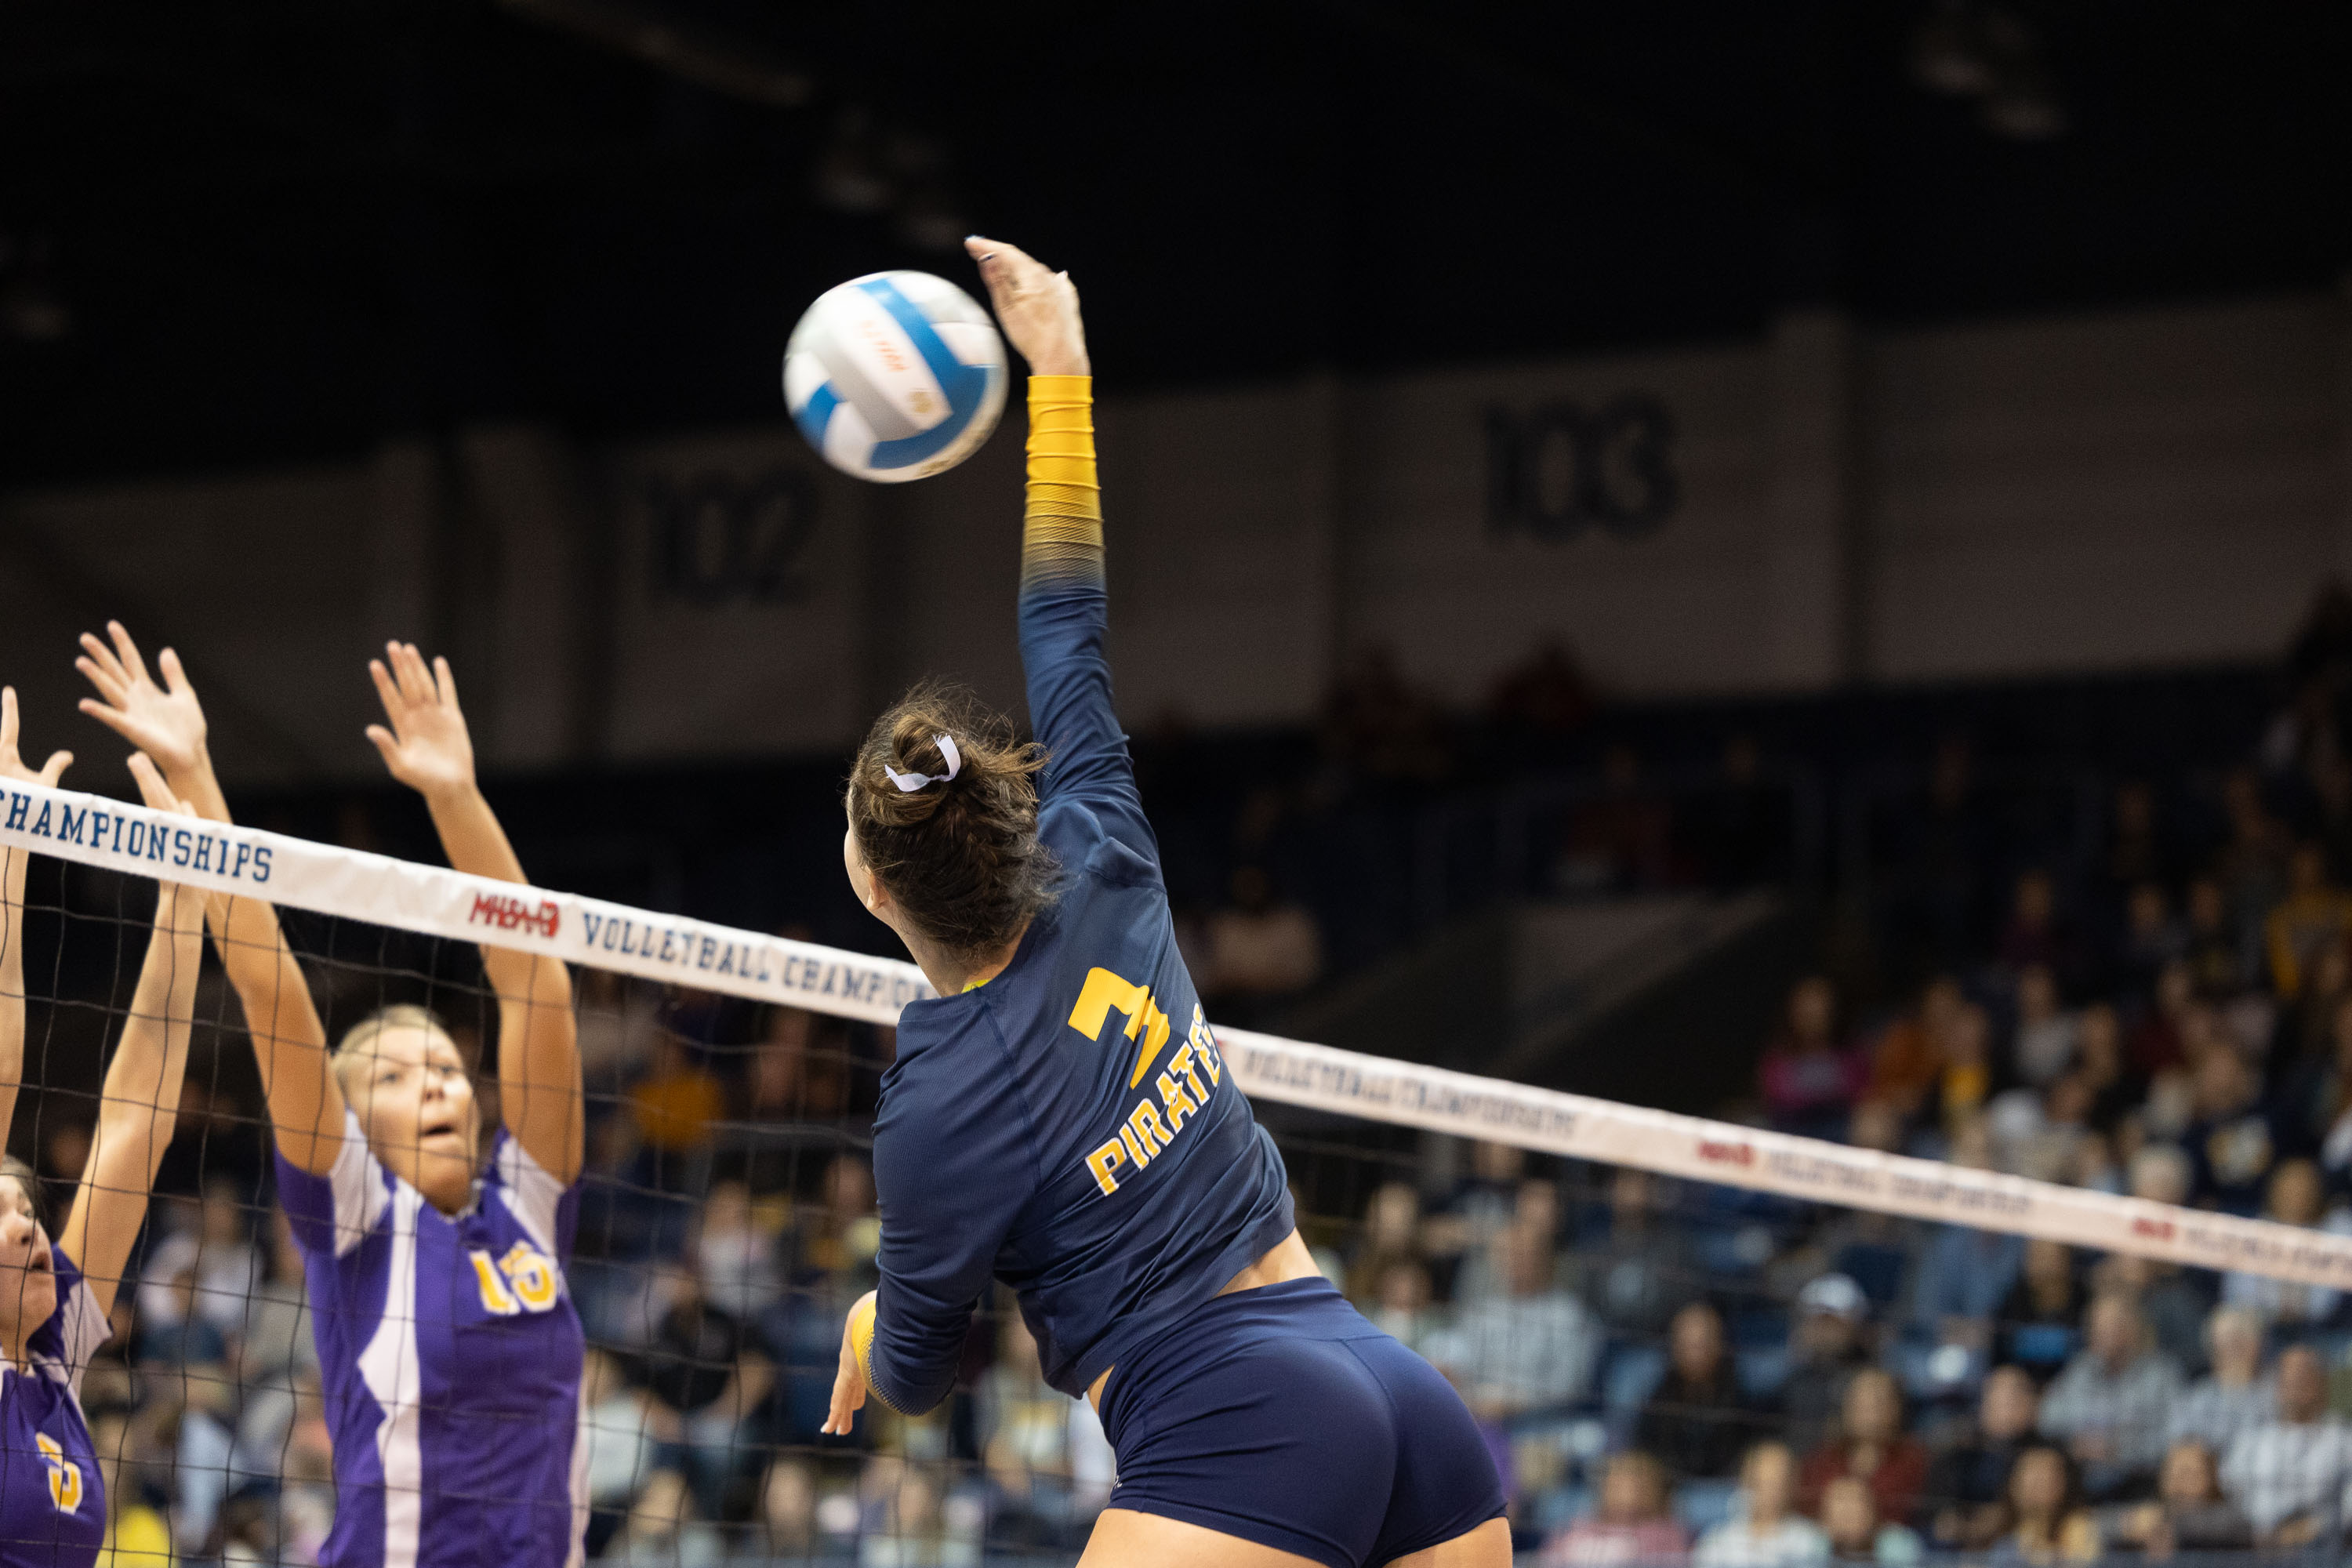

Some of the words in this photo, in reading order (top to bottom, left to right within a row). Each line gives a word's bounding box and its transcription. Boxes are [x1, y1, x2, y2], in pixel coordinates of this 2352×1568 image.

[0, 789, 273, 883] HAMPIONSHIPS
[584, 913, 770, 983] VOLLEYBALL
[1068, 967, 1173, 1090] 3
[1085, 1003, 1221, 1196] PIRATE
[469, 1239, 558, 1316] 15
